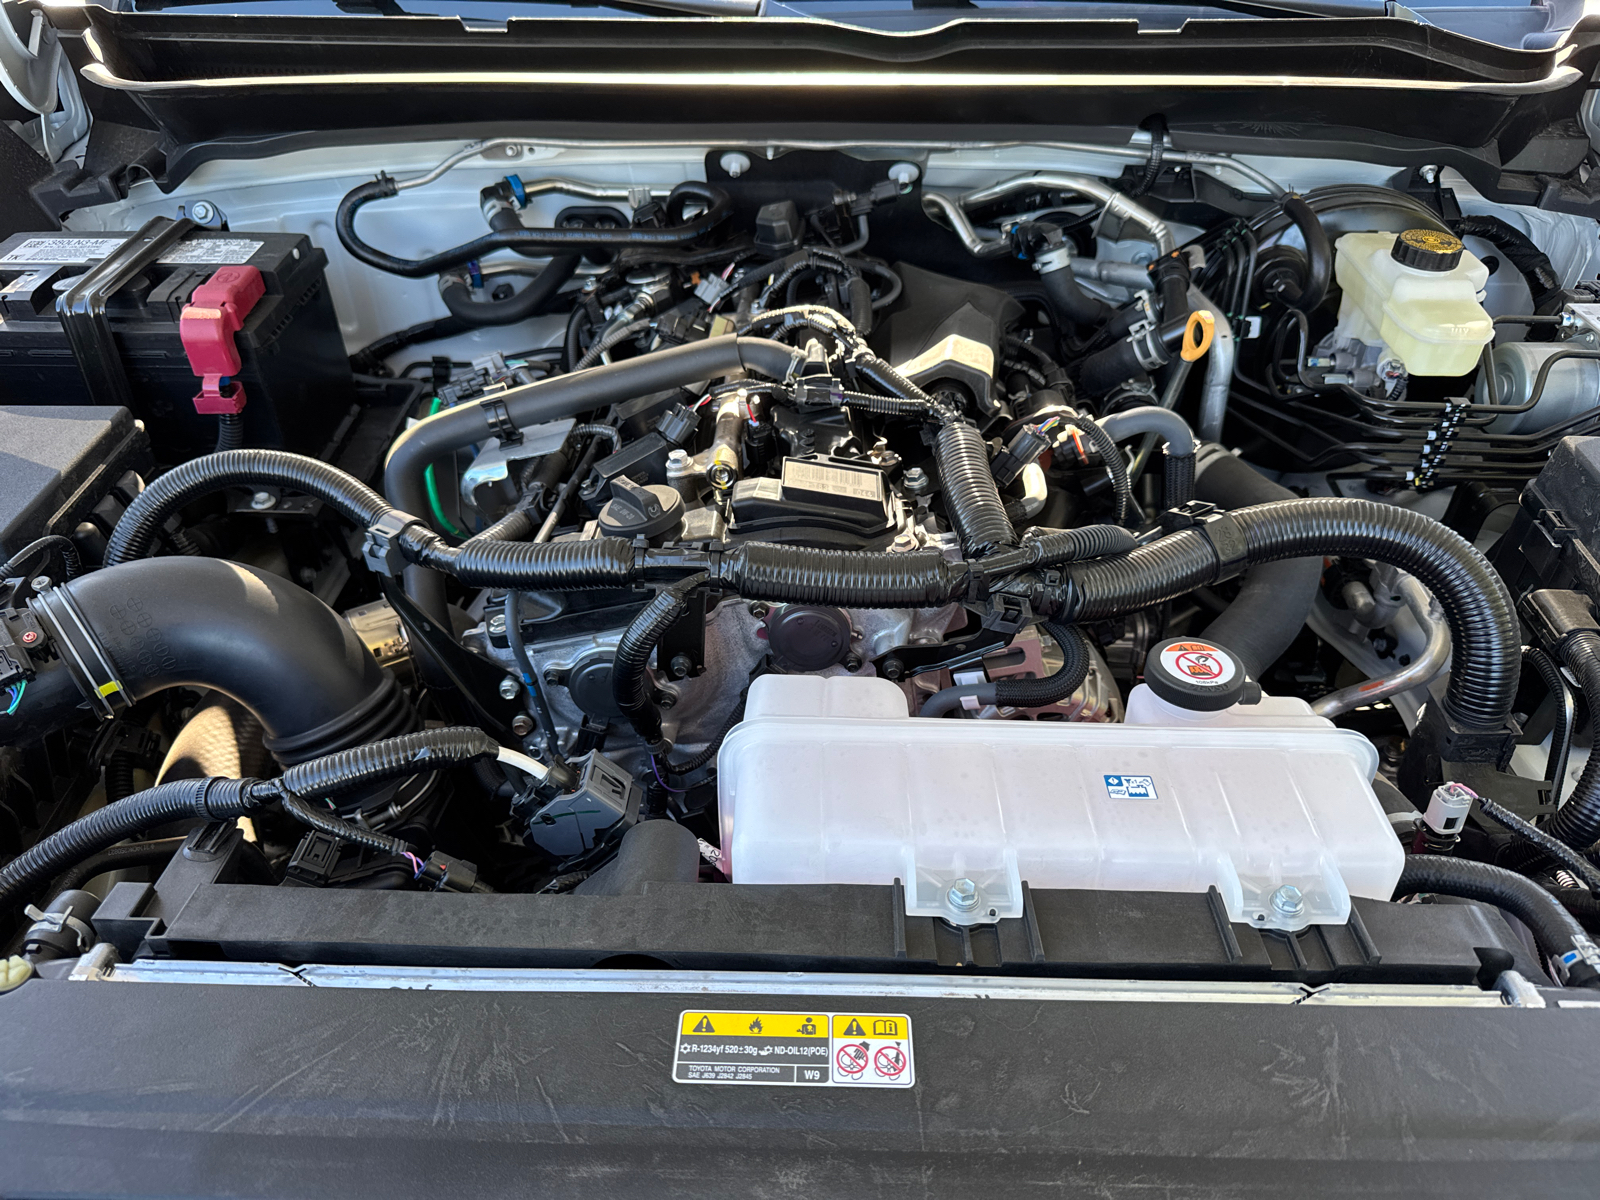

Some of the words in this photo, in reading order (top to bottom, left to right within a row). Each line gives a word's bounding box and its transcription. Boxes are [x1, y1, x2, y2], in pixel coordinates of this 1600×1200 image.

[692, 1043, 724, 1056] R-1234yf
[724, 1045, 758, 1056] 520±30g
[774, 1045, 829, 1057] ND-OIL12(POE)
[804, 1070, 820, 1080] W9
